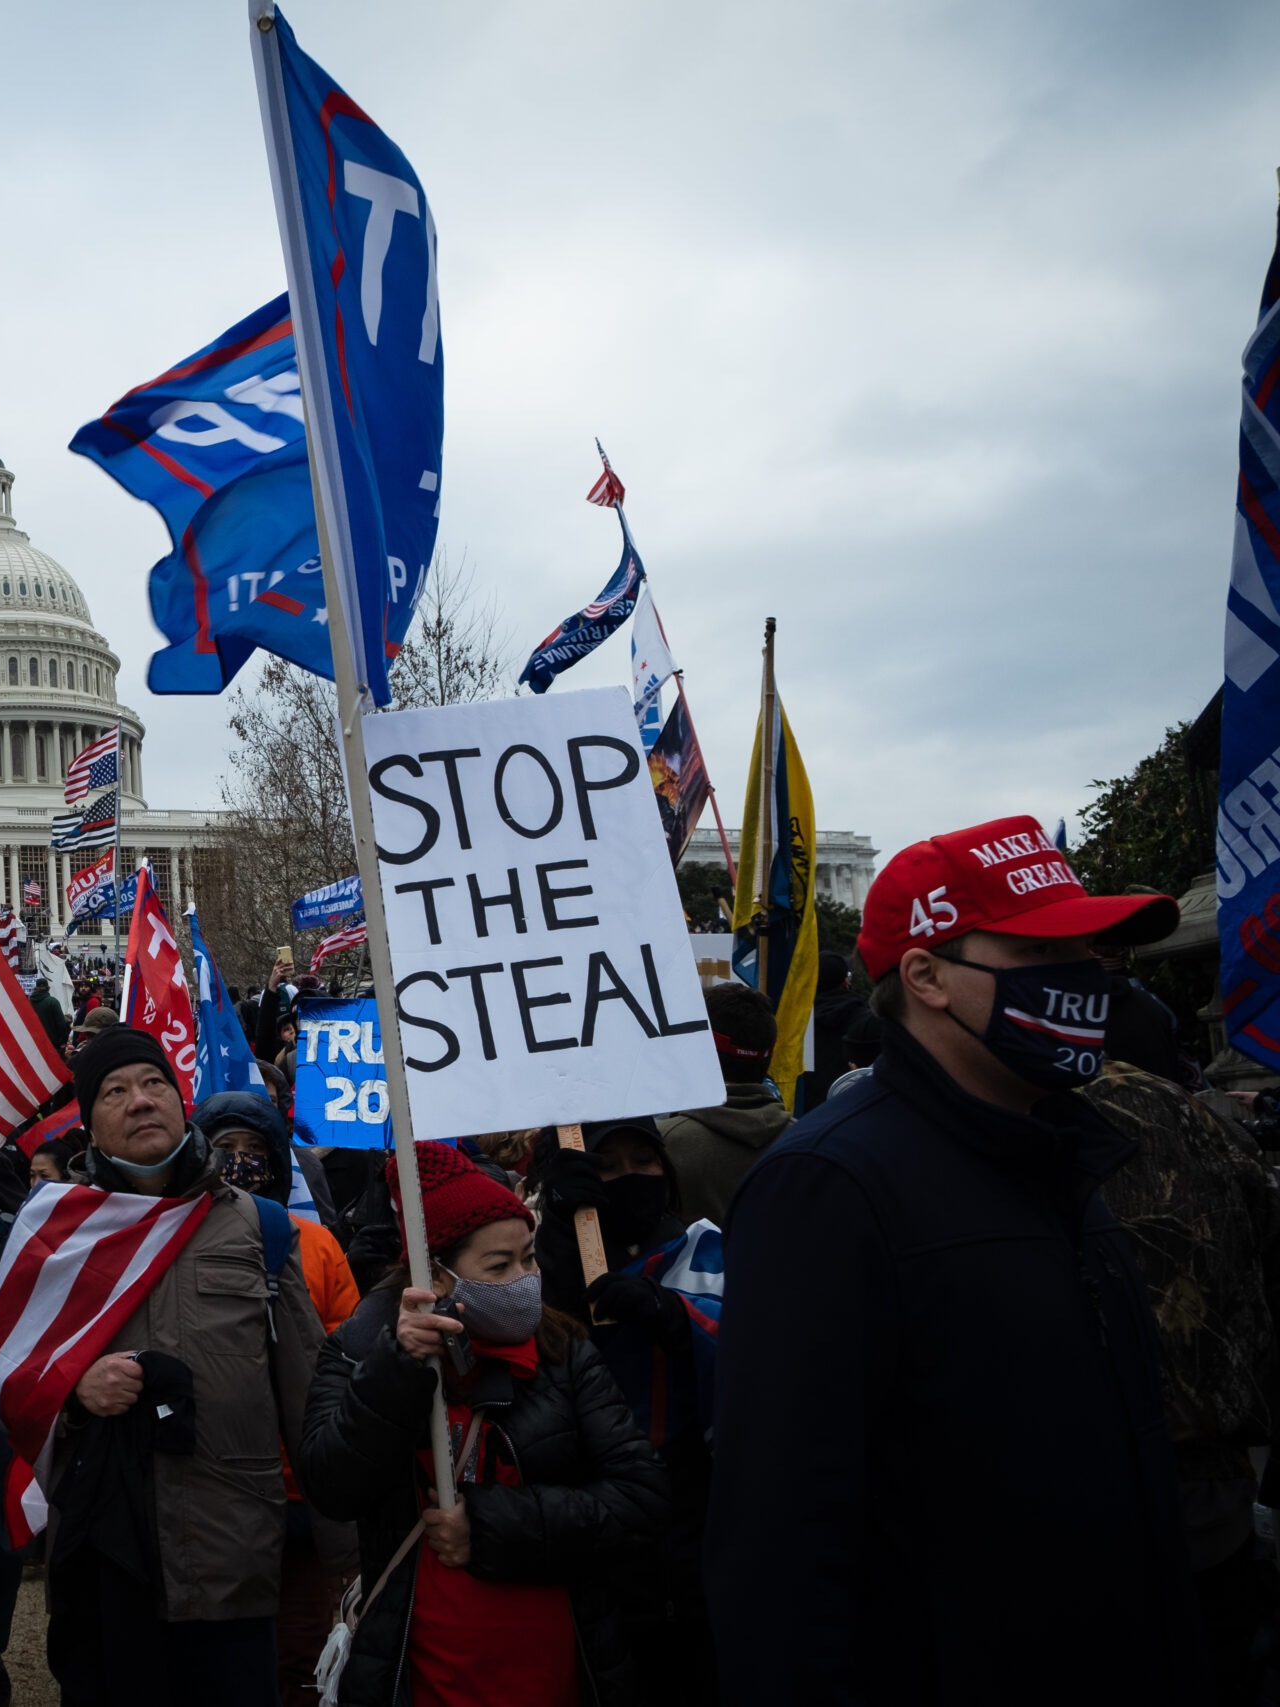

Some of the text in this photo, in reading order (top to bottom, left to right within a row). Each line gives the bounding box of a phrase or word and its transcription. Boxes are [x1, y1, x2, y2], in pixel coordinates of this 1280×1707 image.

[368, 735, 640, 865] STOP
[969, 832, 1040, 868] MAKE
[1006, 861, 1071, 895] GREAT
[395, 859, 599, 945] THE
[909, 886, 958, 937] 45
[394, 944, 709, 1072] STEAL
[1042, 987, 1110, 1023] TRU
[300, 1019, 385, 1064] TRU
[1052, 1047, 1105, 1077] 20
[324, 1076, 391, 1124] 20
